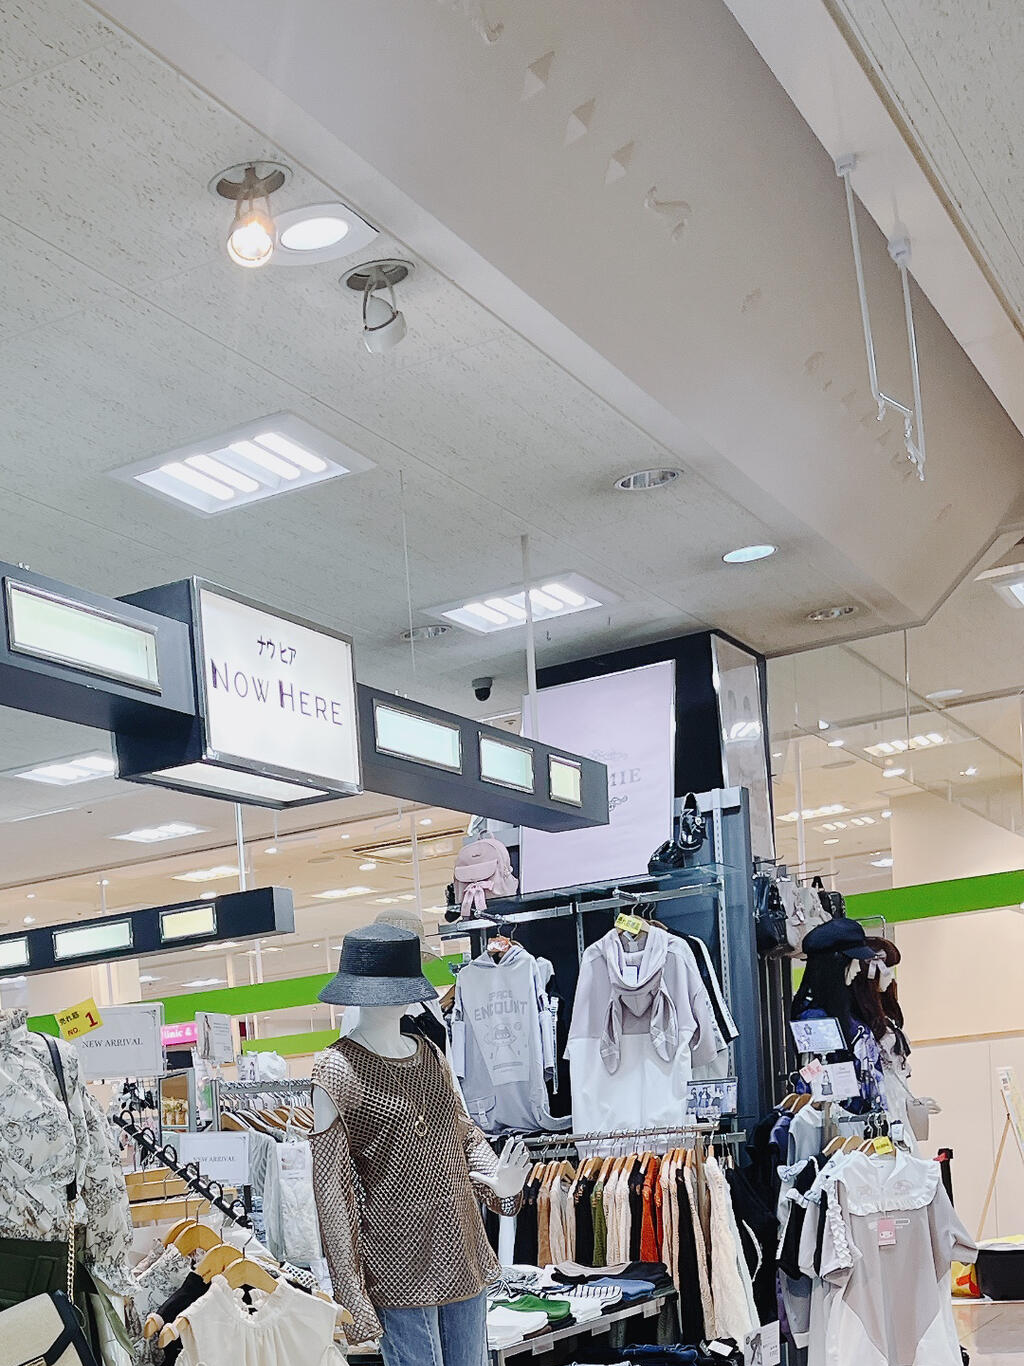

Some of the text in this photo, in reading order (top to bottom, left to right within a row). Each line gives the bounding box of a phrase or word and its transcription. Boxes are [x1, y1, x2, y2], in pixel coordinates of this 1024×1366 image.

[210, 658, 343, 726] NOW HERE
[85, 1011, 98, 1028] 1
[81, 1037, 144, 1049] NEW ARRIVAL
